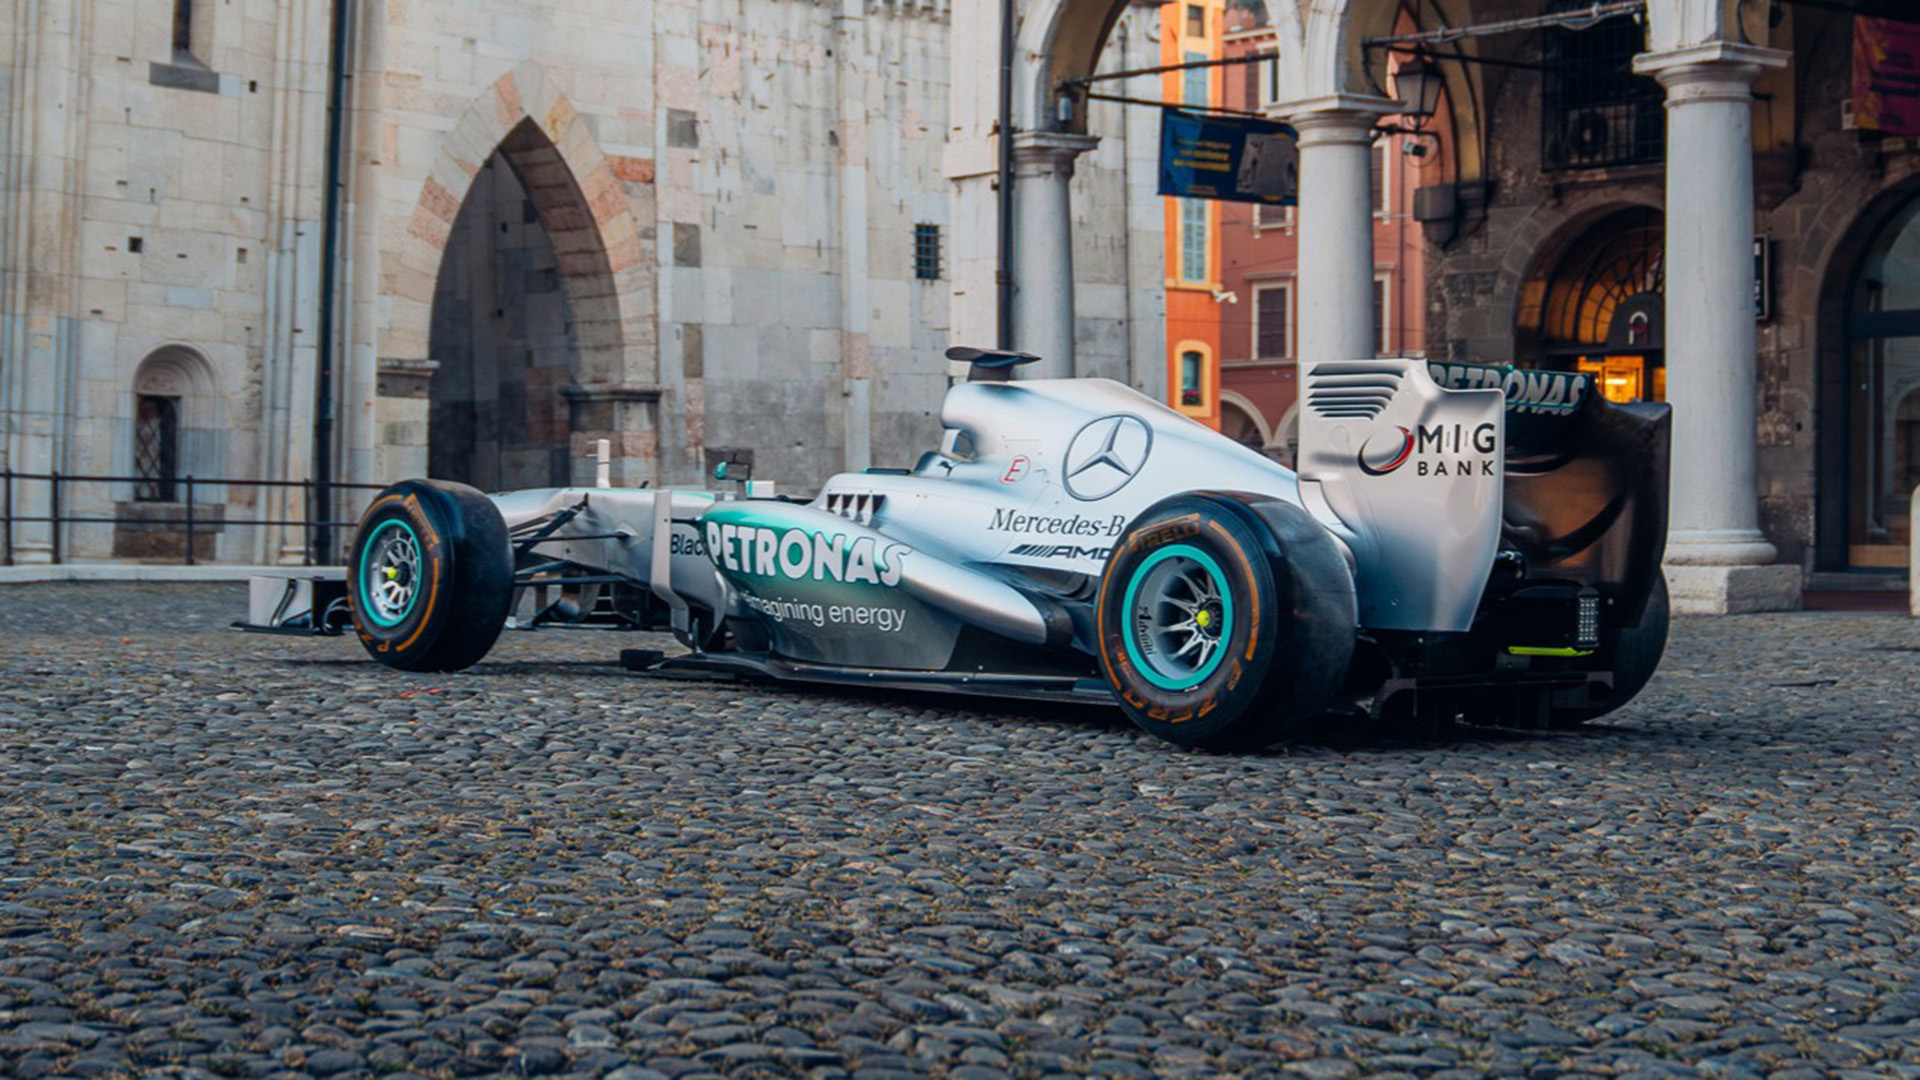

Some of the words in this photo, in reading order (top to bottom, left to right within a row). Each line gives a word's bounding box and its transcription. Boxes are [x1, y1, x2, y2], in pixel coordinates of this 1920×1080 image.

[1003, 458, 1026, 483] E
[1417, 460, 1495, 476] BANK
[987, 507, 1126, 538] Mercedes-B
[671, 533, 708, 556] Blac
[705, 520, 913, 588] PETRONAS
[828, 604, 907, 633] energy
